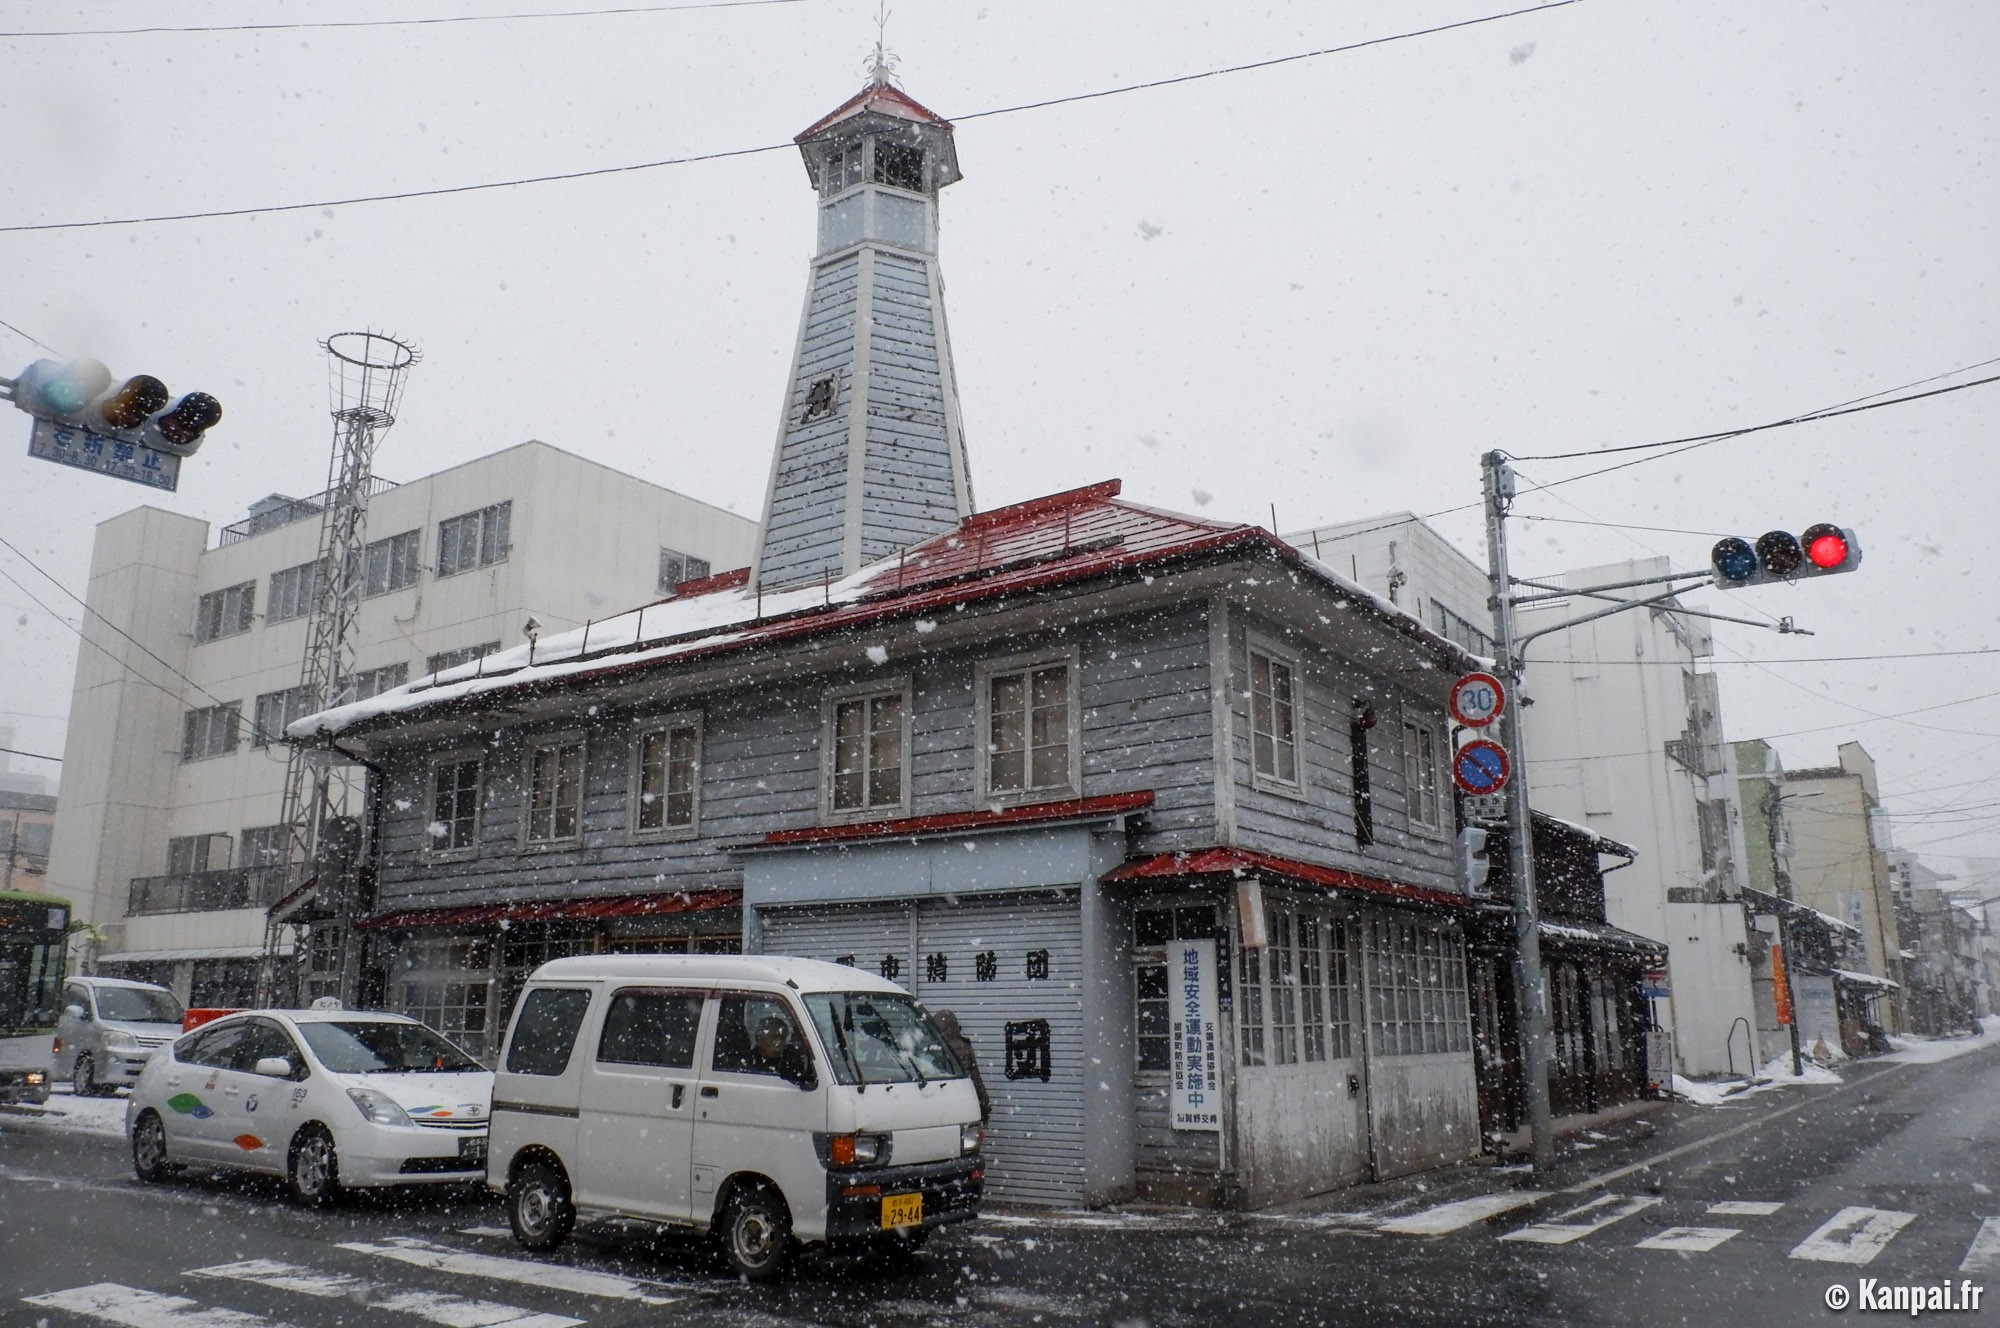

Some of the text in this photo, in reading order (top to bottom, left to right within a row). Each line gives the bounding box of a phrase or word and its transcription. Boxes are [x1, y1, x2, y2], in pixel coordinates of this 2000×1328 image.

[1462, 688, 1492, 712] 30
[1183, 948, 1204, 1109] 地域安全運動実施中
[292, 1088, 308, 1099] 163
